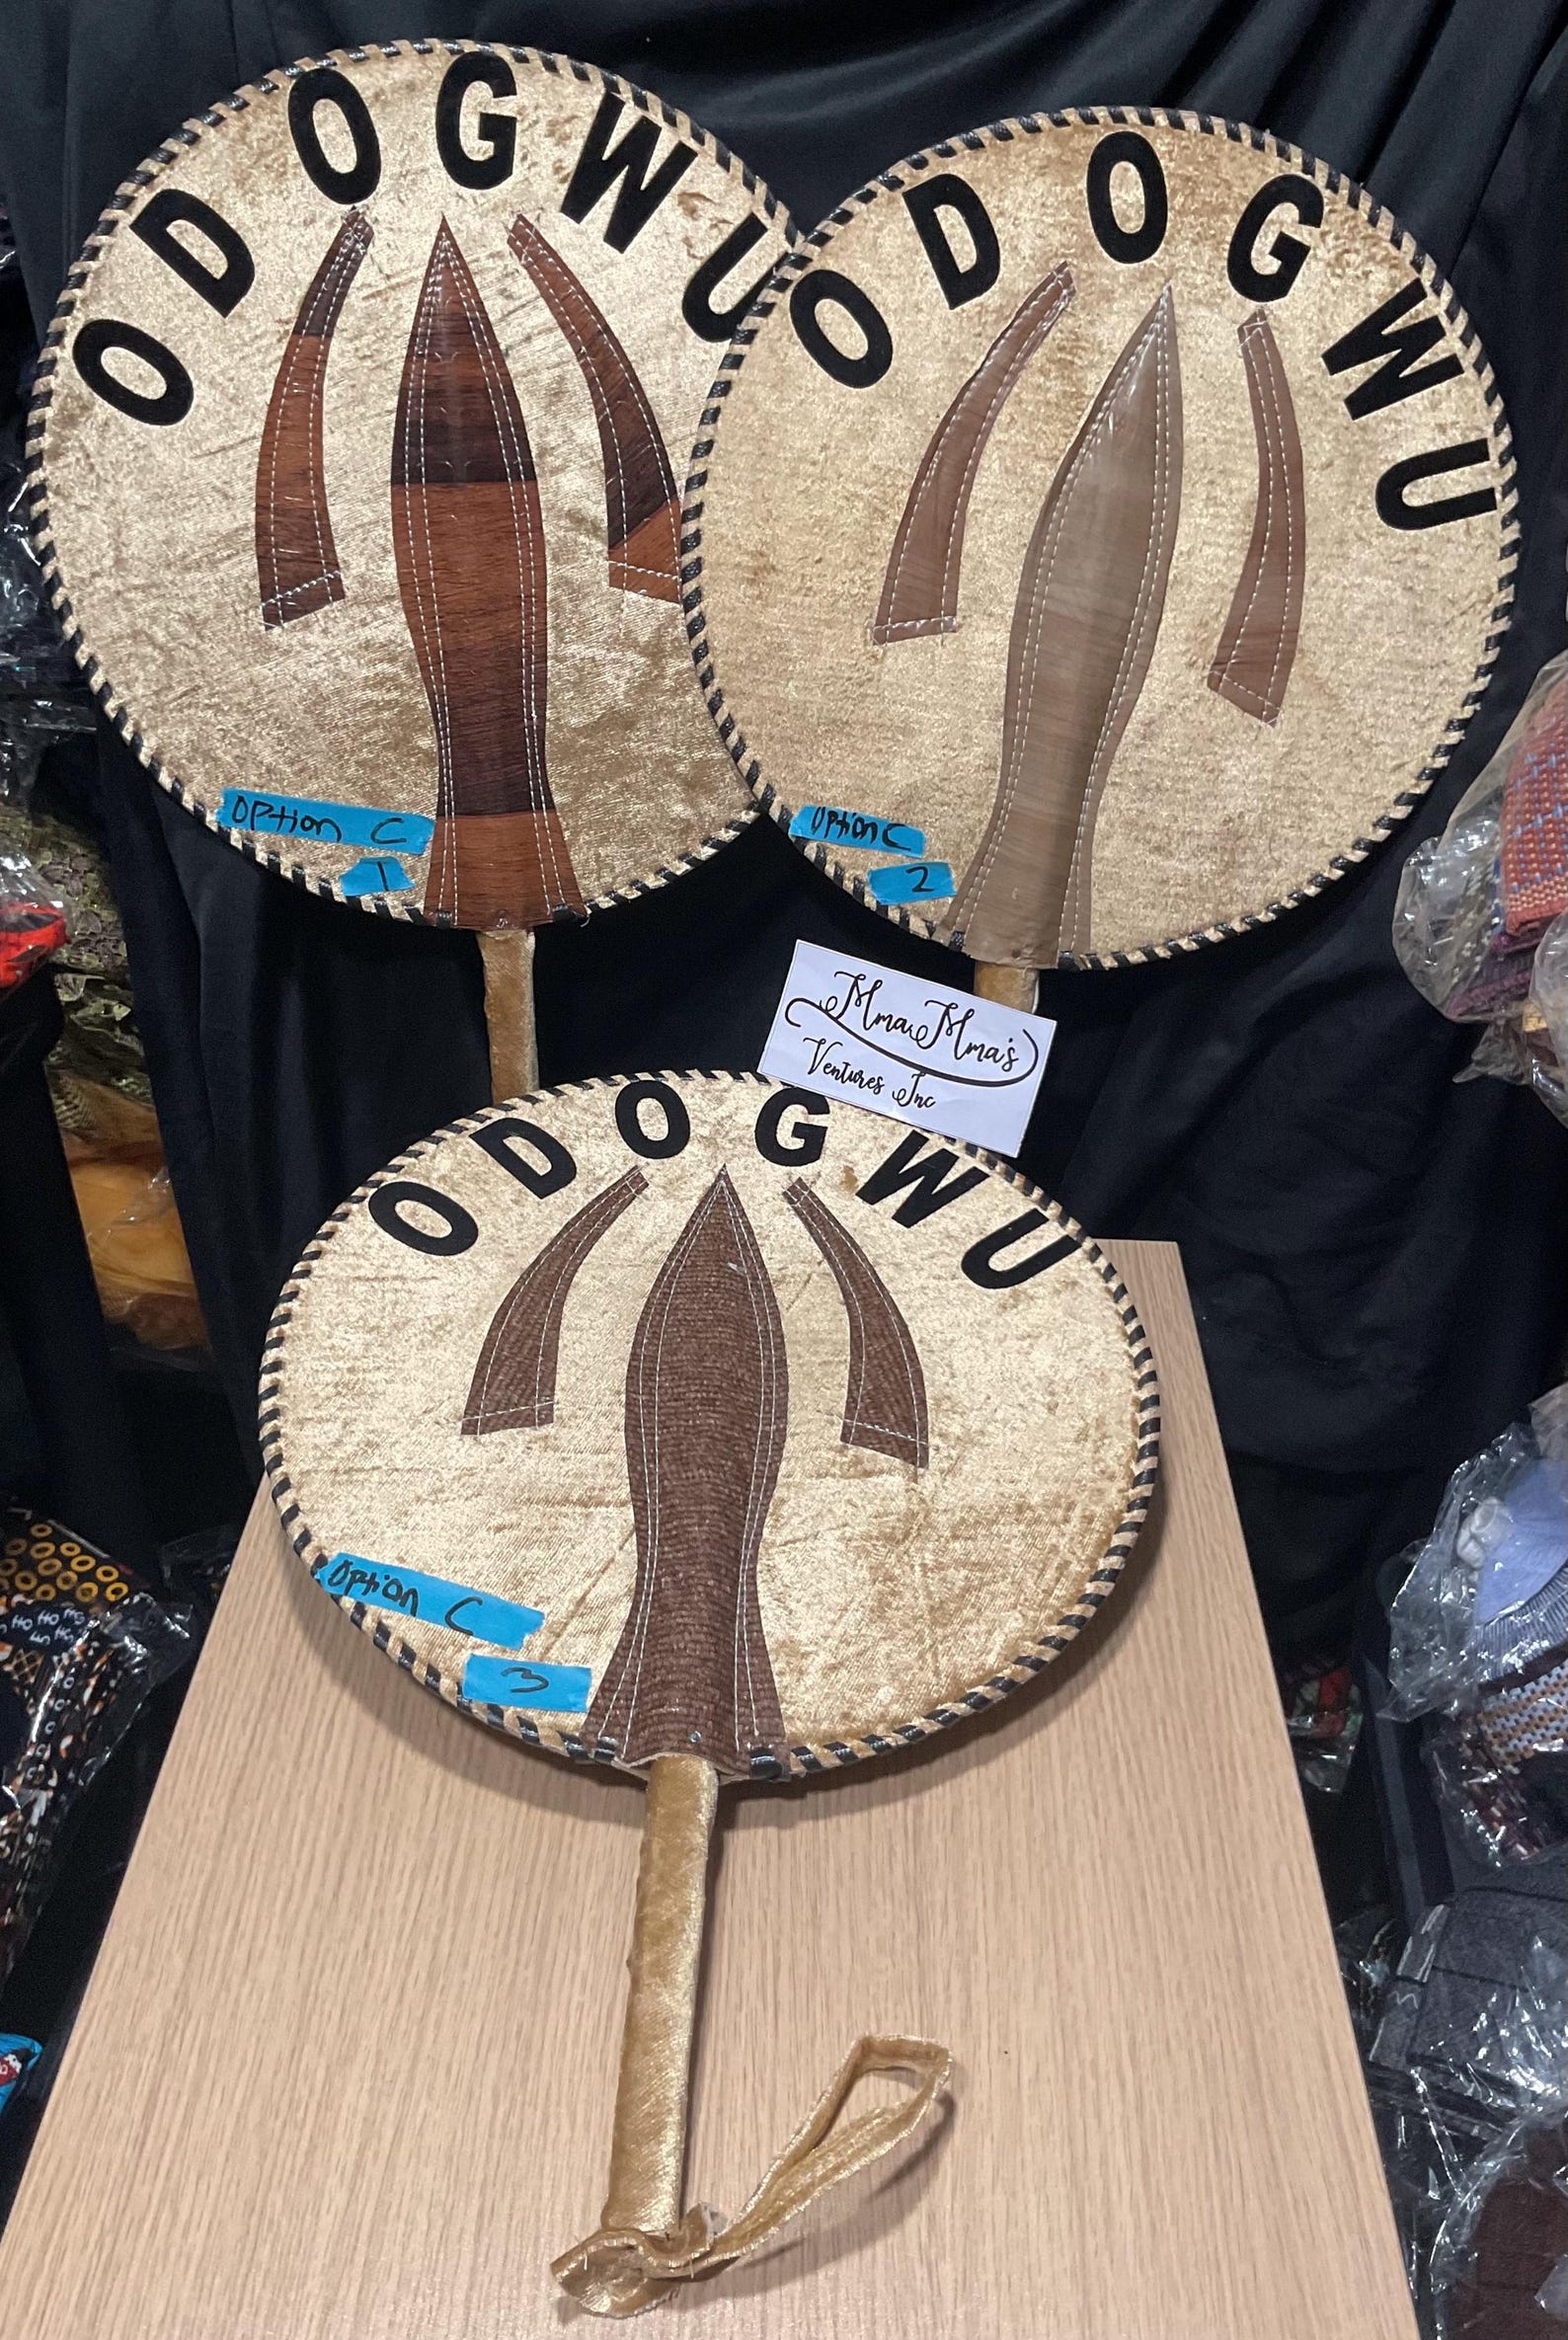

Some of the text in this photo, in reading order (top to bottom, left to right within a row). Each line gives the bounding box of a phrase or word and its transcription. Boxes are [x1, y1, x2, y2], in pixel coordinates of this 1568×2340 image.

[72, 50, 790, 428] ODOGWU
[789, 130, 1497, 531] ODOGWU
[370, 818, 408, 844] C
[882, 822, 912, 852] C
[377, 861, 389, 892] 1
[905, 866, 935, 893] 2
[820, 971, 1021, 1072] Mma Mma's
[803, 1037, 937, 1109] Ventures Inc
[369, 1080, 1082, 1290] ODOGWU
[445, 1597, 483, 1636] C
[501, 1668, 549, 1693] 3
